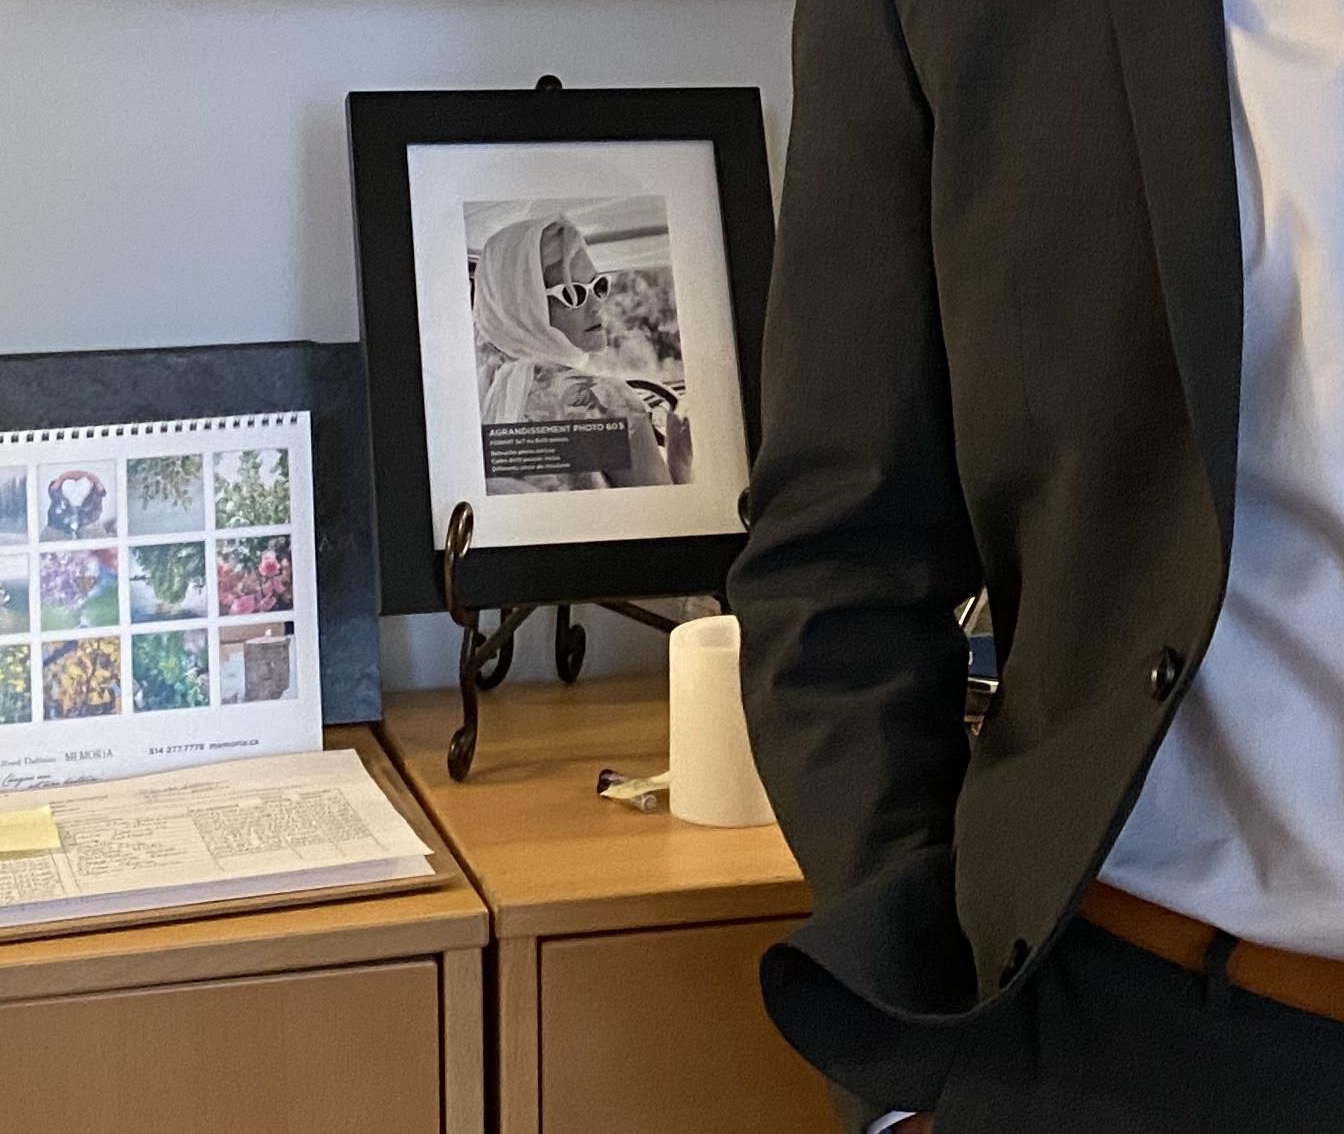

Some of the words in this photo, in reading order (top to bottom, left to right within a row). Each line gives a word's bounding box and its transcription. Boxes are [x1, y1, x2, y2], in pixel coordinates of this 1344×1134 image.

[489, 425, 571, 437] AGRANDISSEMENT
[573, 424, 604, 432] PHOTO
[65, 748, 113, 762] MEMORIA
